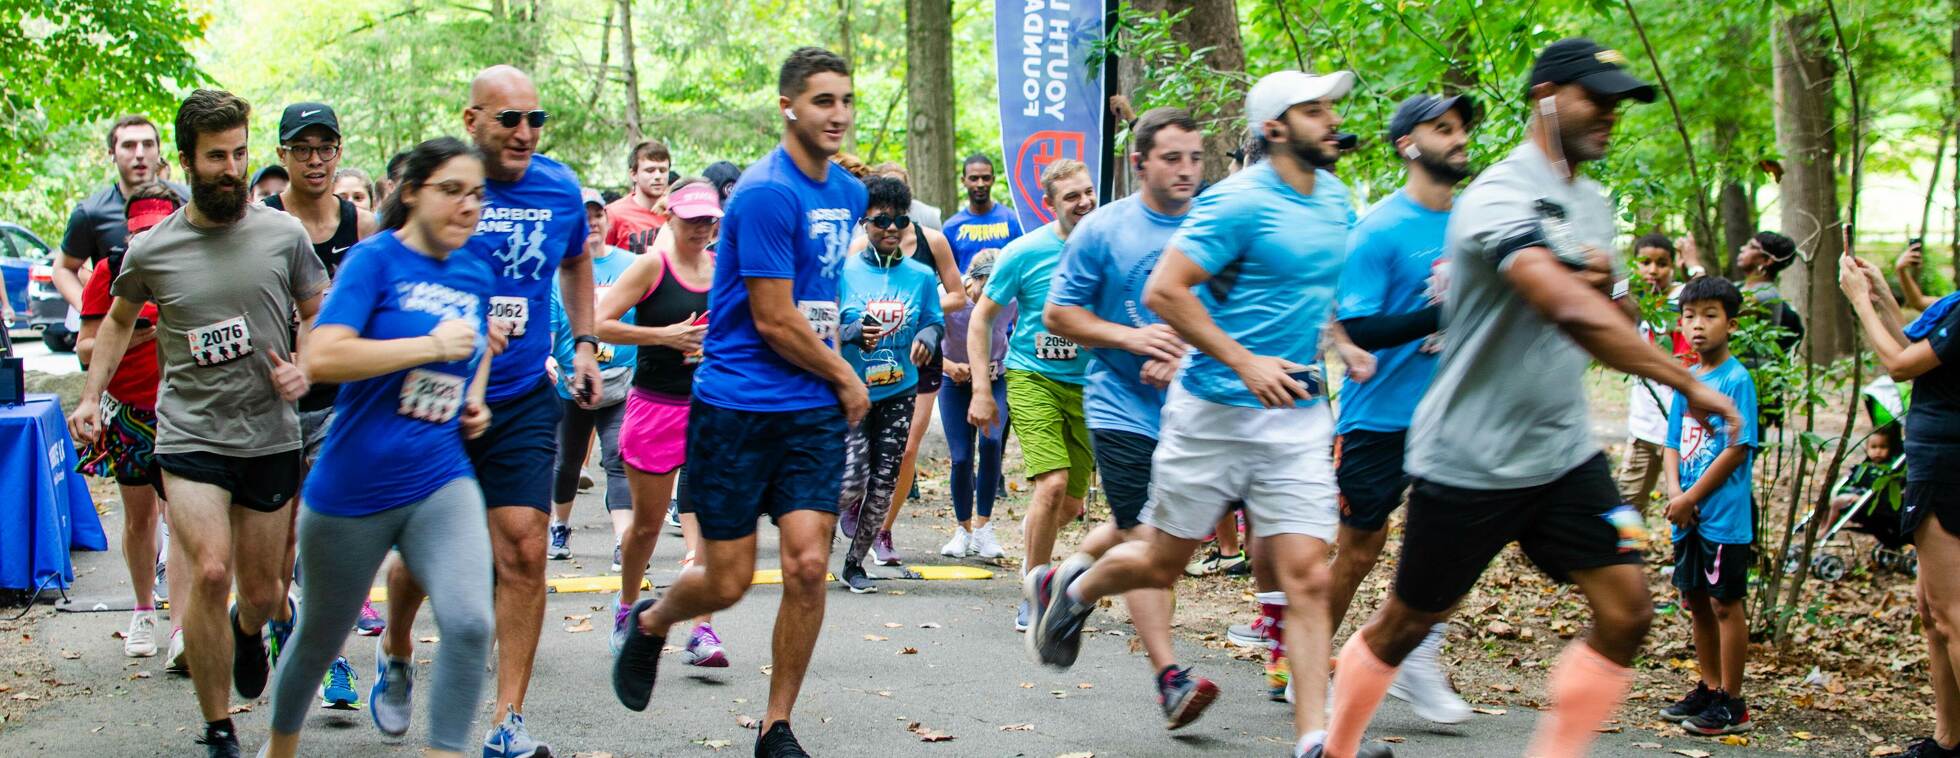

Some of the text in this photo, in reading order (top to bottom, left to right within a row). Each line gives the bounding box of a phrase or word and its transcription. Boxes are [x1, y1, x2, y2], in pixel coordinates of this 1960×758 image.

[480, 206, 553, 221] ARBOR
[475, 221, 514, 233] ANE
[487, 302, 524, 318] 2062
[201, 324, 243, 347] 2076
[1681, 425, 1702, 443] LF
